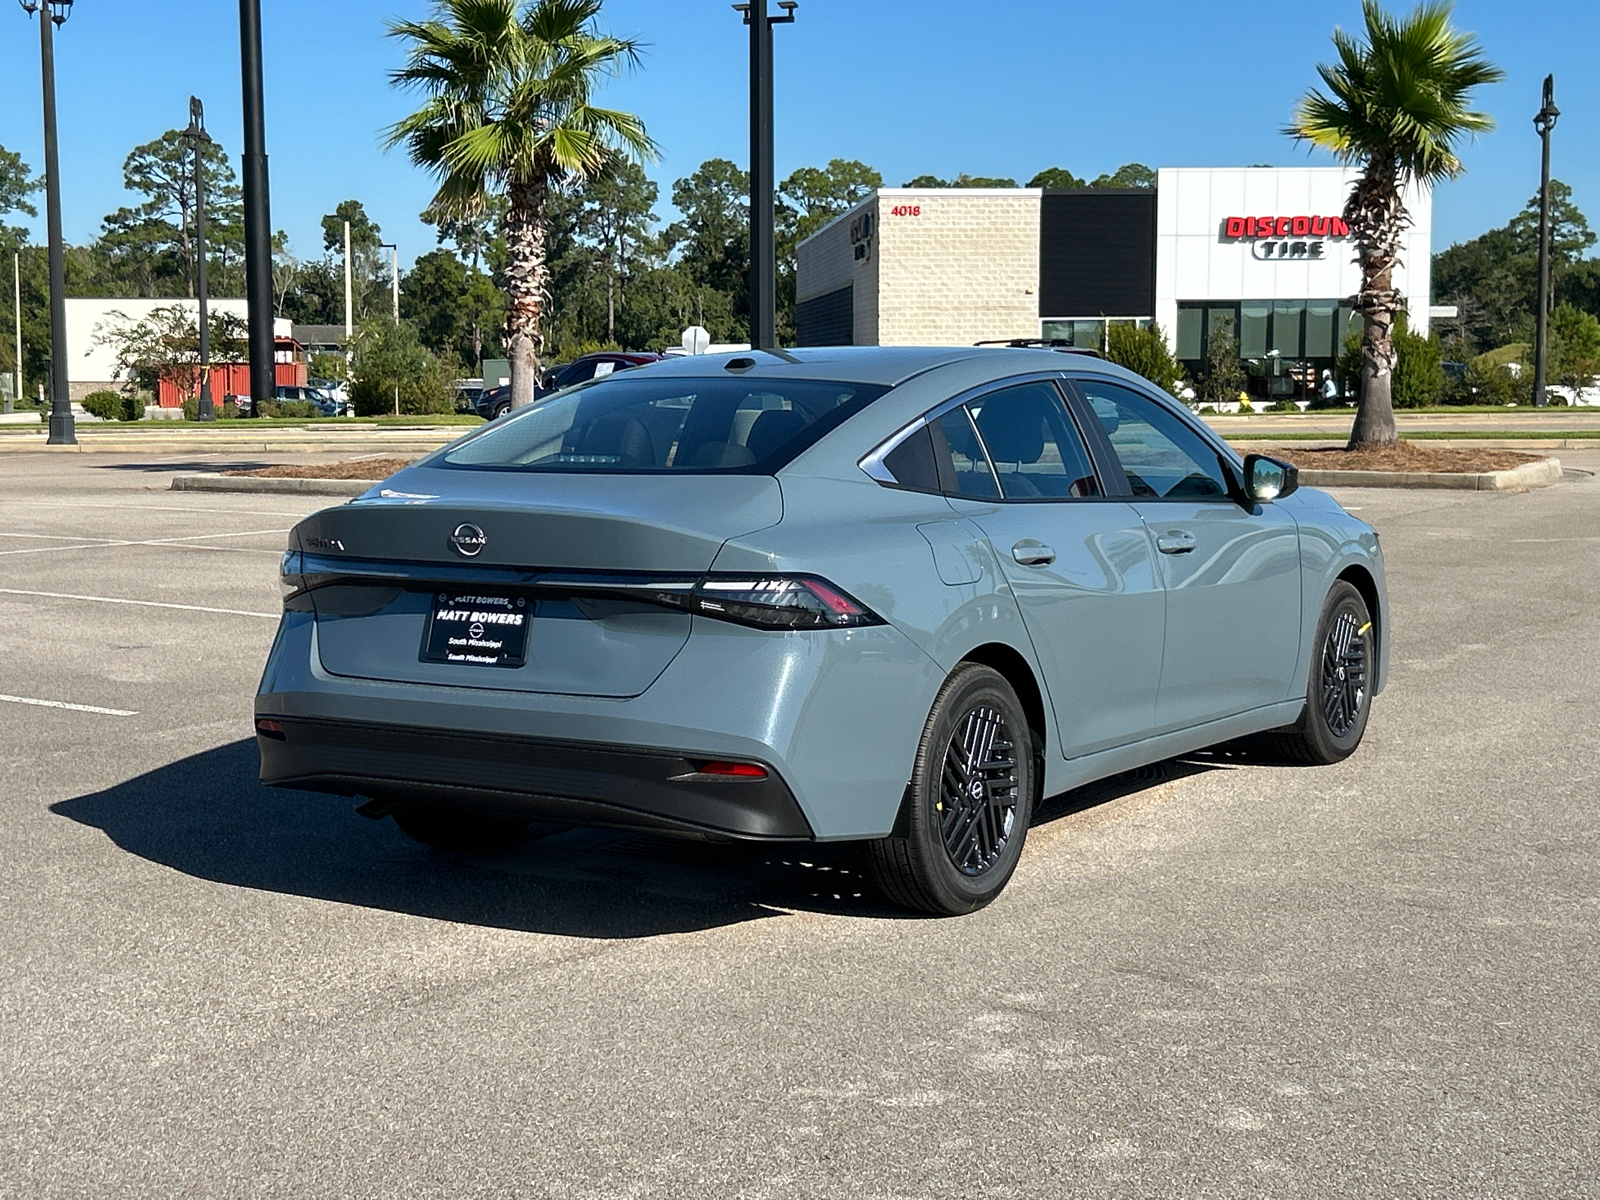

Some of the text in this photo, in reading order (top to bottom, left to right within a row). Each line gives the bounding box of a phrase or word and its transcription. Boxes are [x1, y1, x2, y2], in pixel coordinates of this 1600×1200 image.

[891, 205, 921, 217] 4018
[1226, 216, 1350, 238] DISCOUN
[1259, 241, 1325, 258] TIRE
[451, 536, 487, 544] NISSAN
[455, 595, 509, 606] MATT BOWERS
[436, 609, 524, 625] MATT BOWERS
[448, 637, 503, 648] South Mississippi
[447, 653, 498, 664] South Mississippi
